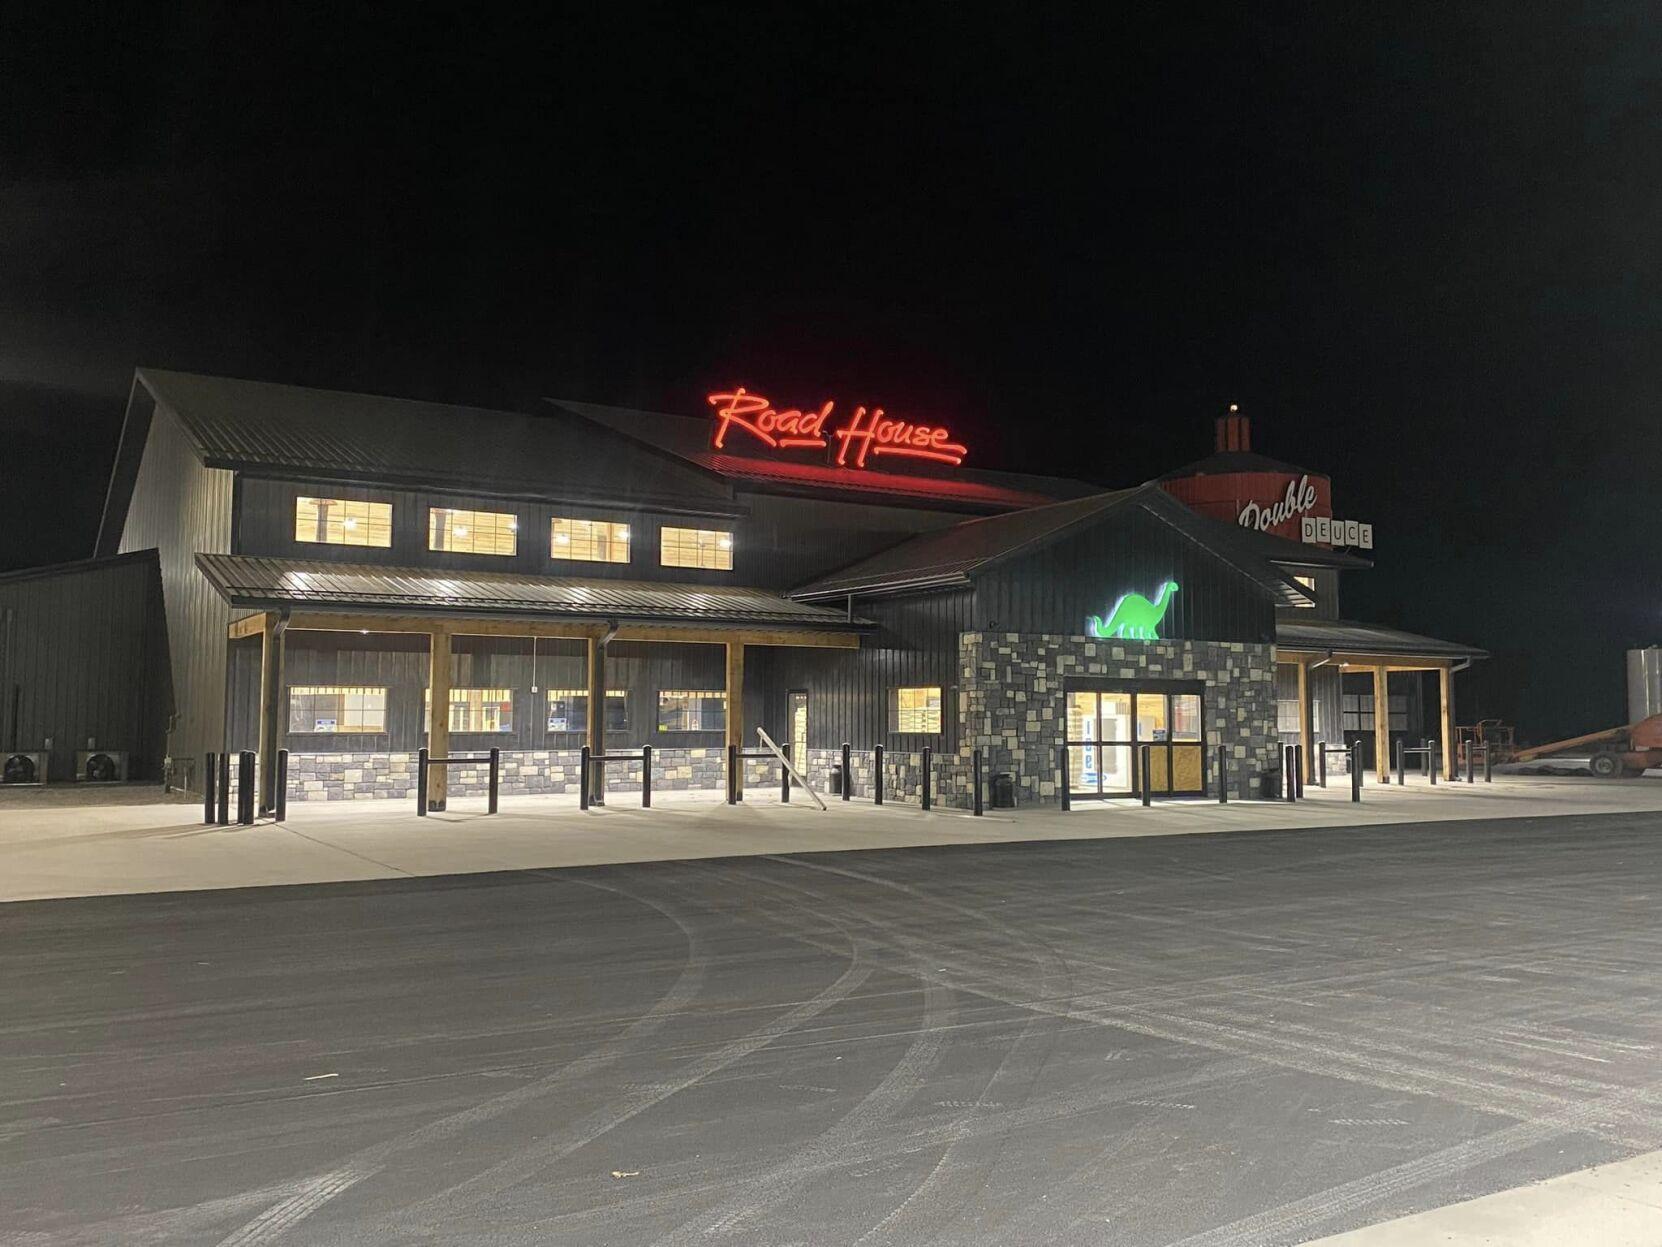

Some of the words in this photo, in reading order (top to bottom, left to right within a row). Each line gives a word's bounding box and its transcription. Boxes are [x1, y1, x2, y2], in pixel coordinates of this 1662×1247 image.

[708, 387, 834, 448] Road
[836, 406, 968, 467] House
[1238, 474, 1318, 531] Double
[1303, 520, 1371, 546] DEUCE
